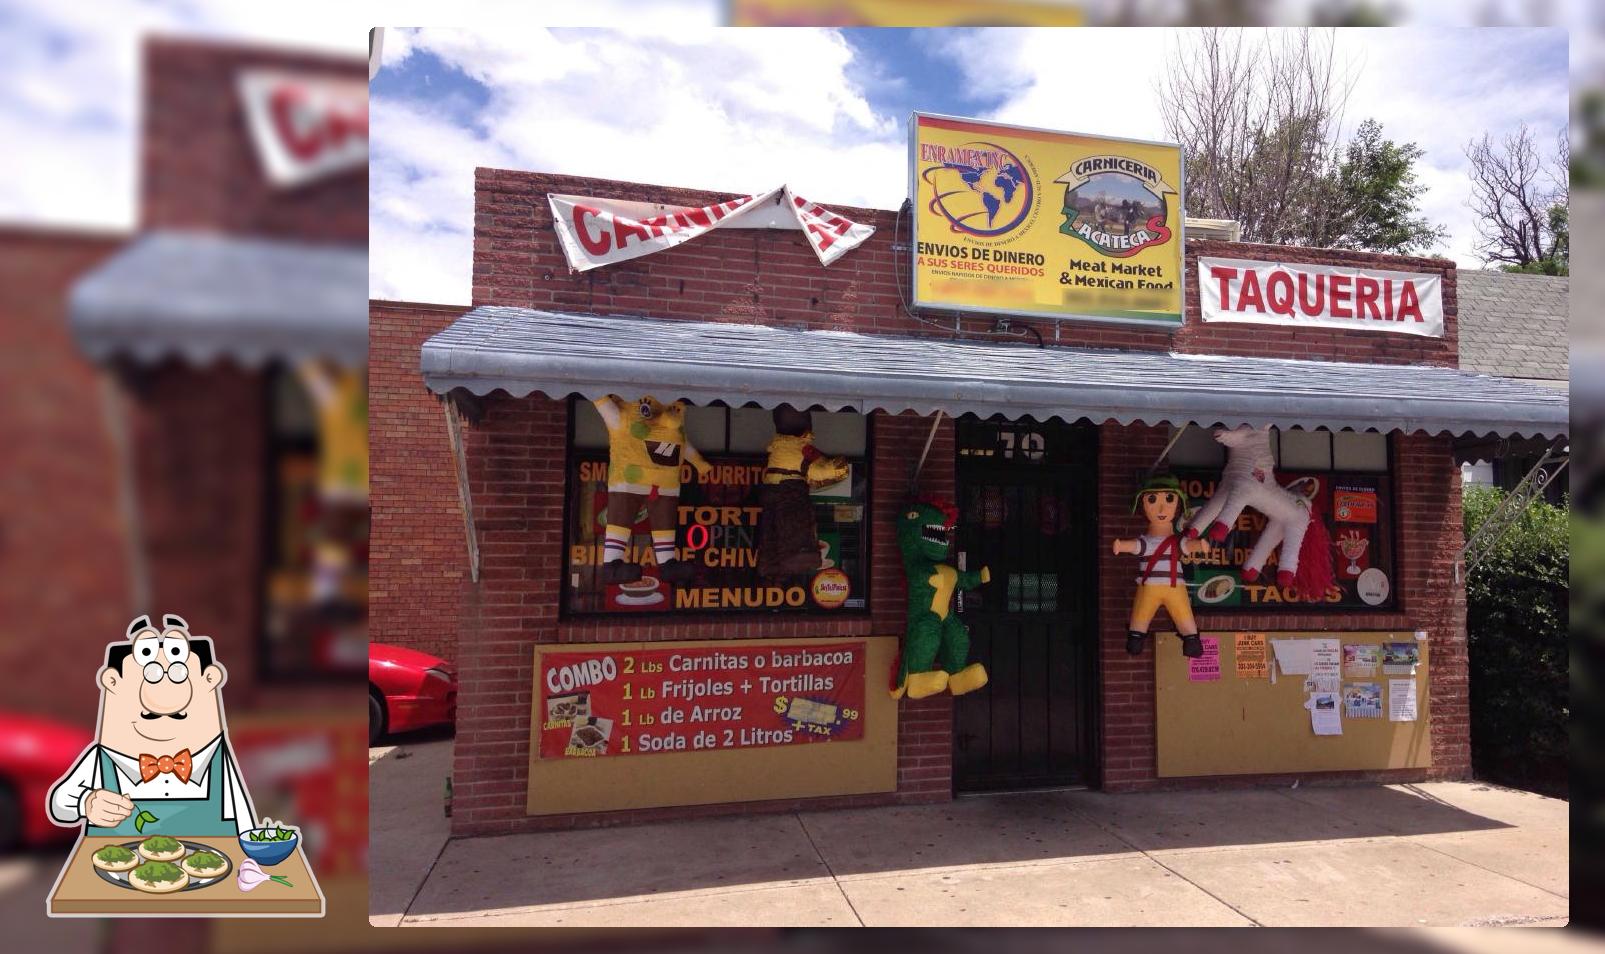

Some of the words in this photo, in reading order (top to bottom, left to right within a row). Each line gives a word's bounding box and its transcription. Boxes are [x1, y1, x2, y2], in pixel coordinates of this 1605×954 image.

[1075, 158, 1157, 183] CARNICERIA
[1059, 206, 1172, 252] ZACATECAS
[917, 241, 968, 259] ENVIOS
[972, 248, 990, 261] DE
[993, 249, 1045, 266] DINERO
[917, 257, 925, 266] A
[927, 257, 948, 268] SUS
[950, 260, 984, 272] SERES
[986, 262, 1045, 277] QUERIDOS
[1070, 259, 1107, 272] Meat
[1111, 262, 1163, 277] Market
[1059, 272, 1072, 285] &
[1074, 274, 1134, 289] Mexican
[1211, 266, 1424, 323] TAQUERIA
[677, 505, 763, 526] TORT
[685, 523, 755, 550] OPEN
[704, 546, 759, 568] CHIV
[676, 586, 806, 609] MENUDO
[1246, 584, 1344, 604] TACS
[623, 657, 635, 674] 2
[641, 661, 663, 673] Lbs
[669, 652, 749, 672] Carnitas
[754, 655, 766, 669] o
[771, 649, 853, 668] barbacoa
[547, 656, 617, 693] COMBO
[623, 682, 633, 700] 1
[640, 687, 655, 700] Lb
[662, 678, 734, 702] Frijoles
[740, 679, 752, 694] +
[759, 674, 834, 694] Tortillas
[621, 709, 632, 726] 1
[639, 712, 654, 726] Lb
[660, 706, 684, 724] de
[690, 705, 743, 723] Arroz
[620, 735, 631, 753] 1
[638, 732, 686, 752] Soda
[693, 726, 717, 749] de
[723, 724, 734, 746] 2
[740, 727, 793, 746] Litros
[808, 723, 832, 736] TAX
